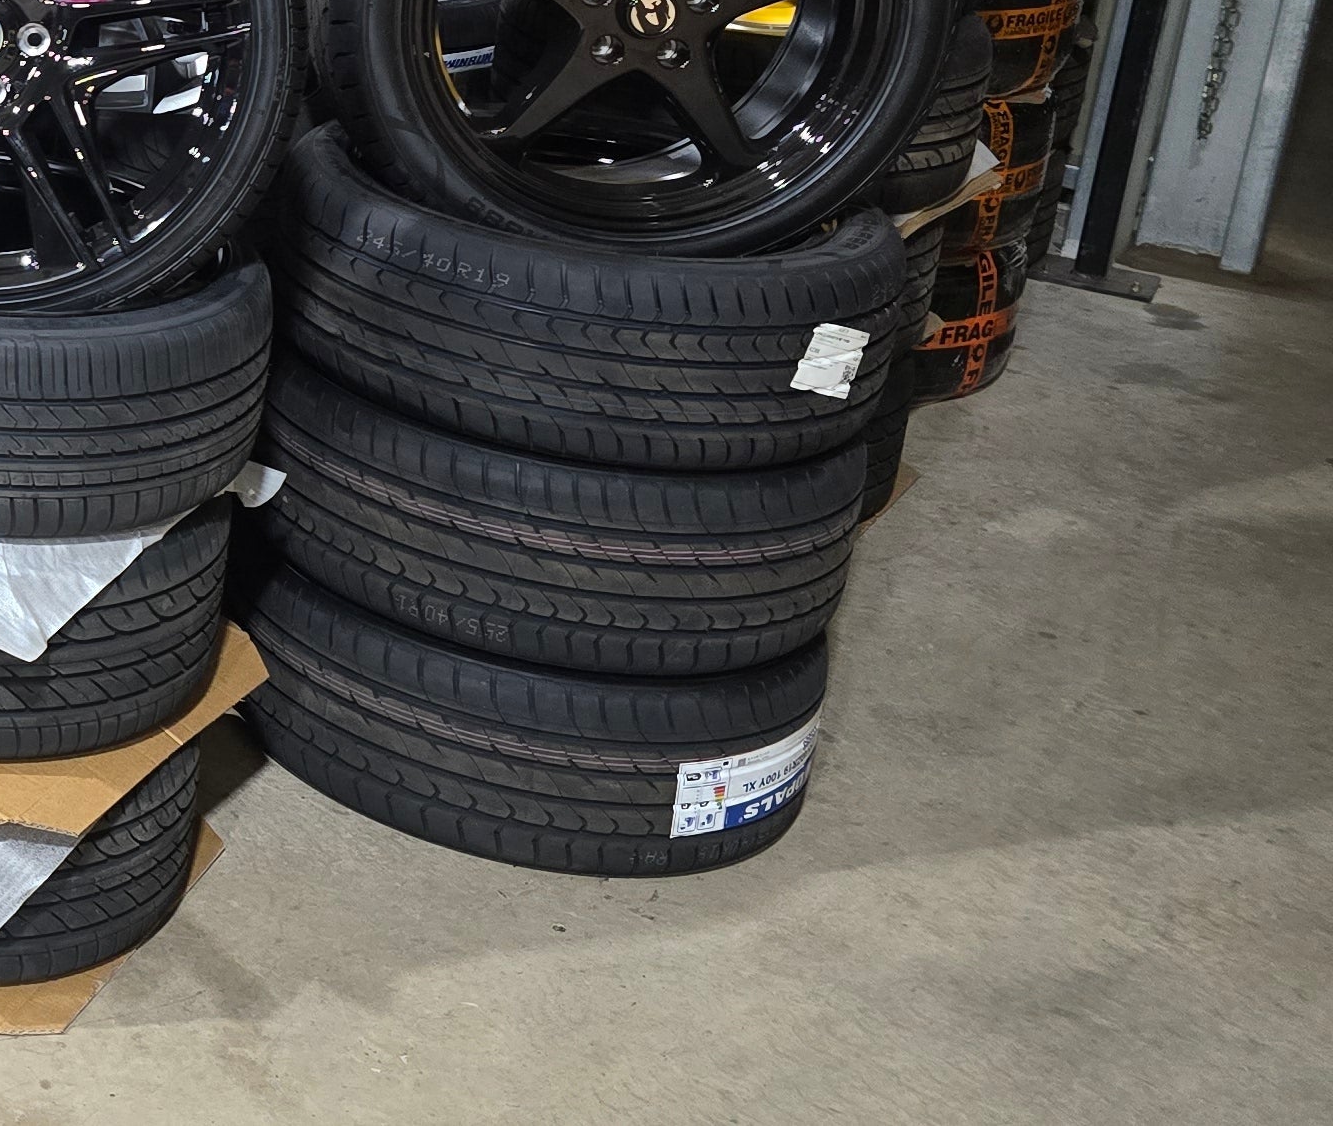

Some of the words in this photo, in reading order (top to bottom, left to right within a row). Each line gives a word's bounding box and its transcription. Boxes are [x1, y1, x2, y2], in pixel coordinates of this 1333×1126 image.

[1006, 7, 1064, 27] FRAGILE
[939, 320, 994, 345] FRAG
[743, 782, 756, 793] XL
[759, 770, 782, 787] 100Y
[743, 772, 806, 820] OPALS
